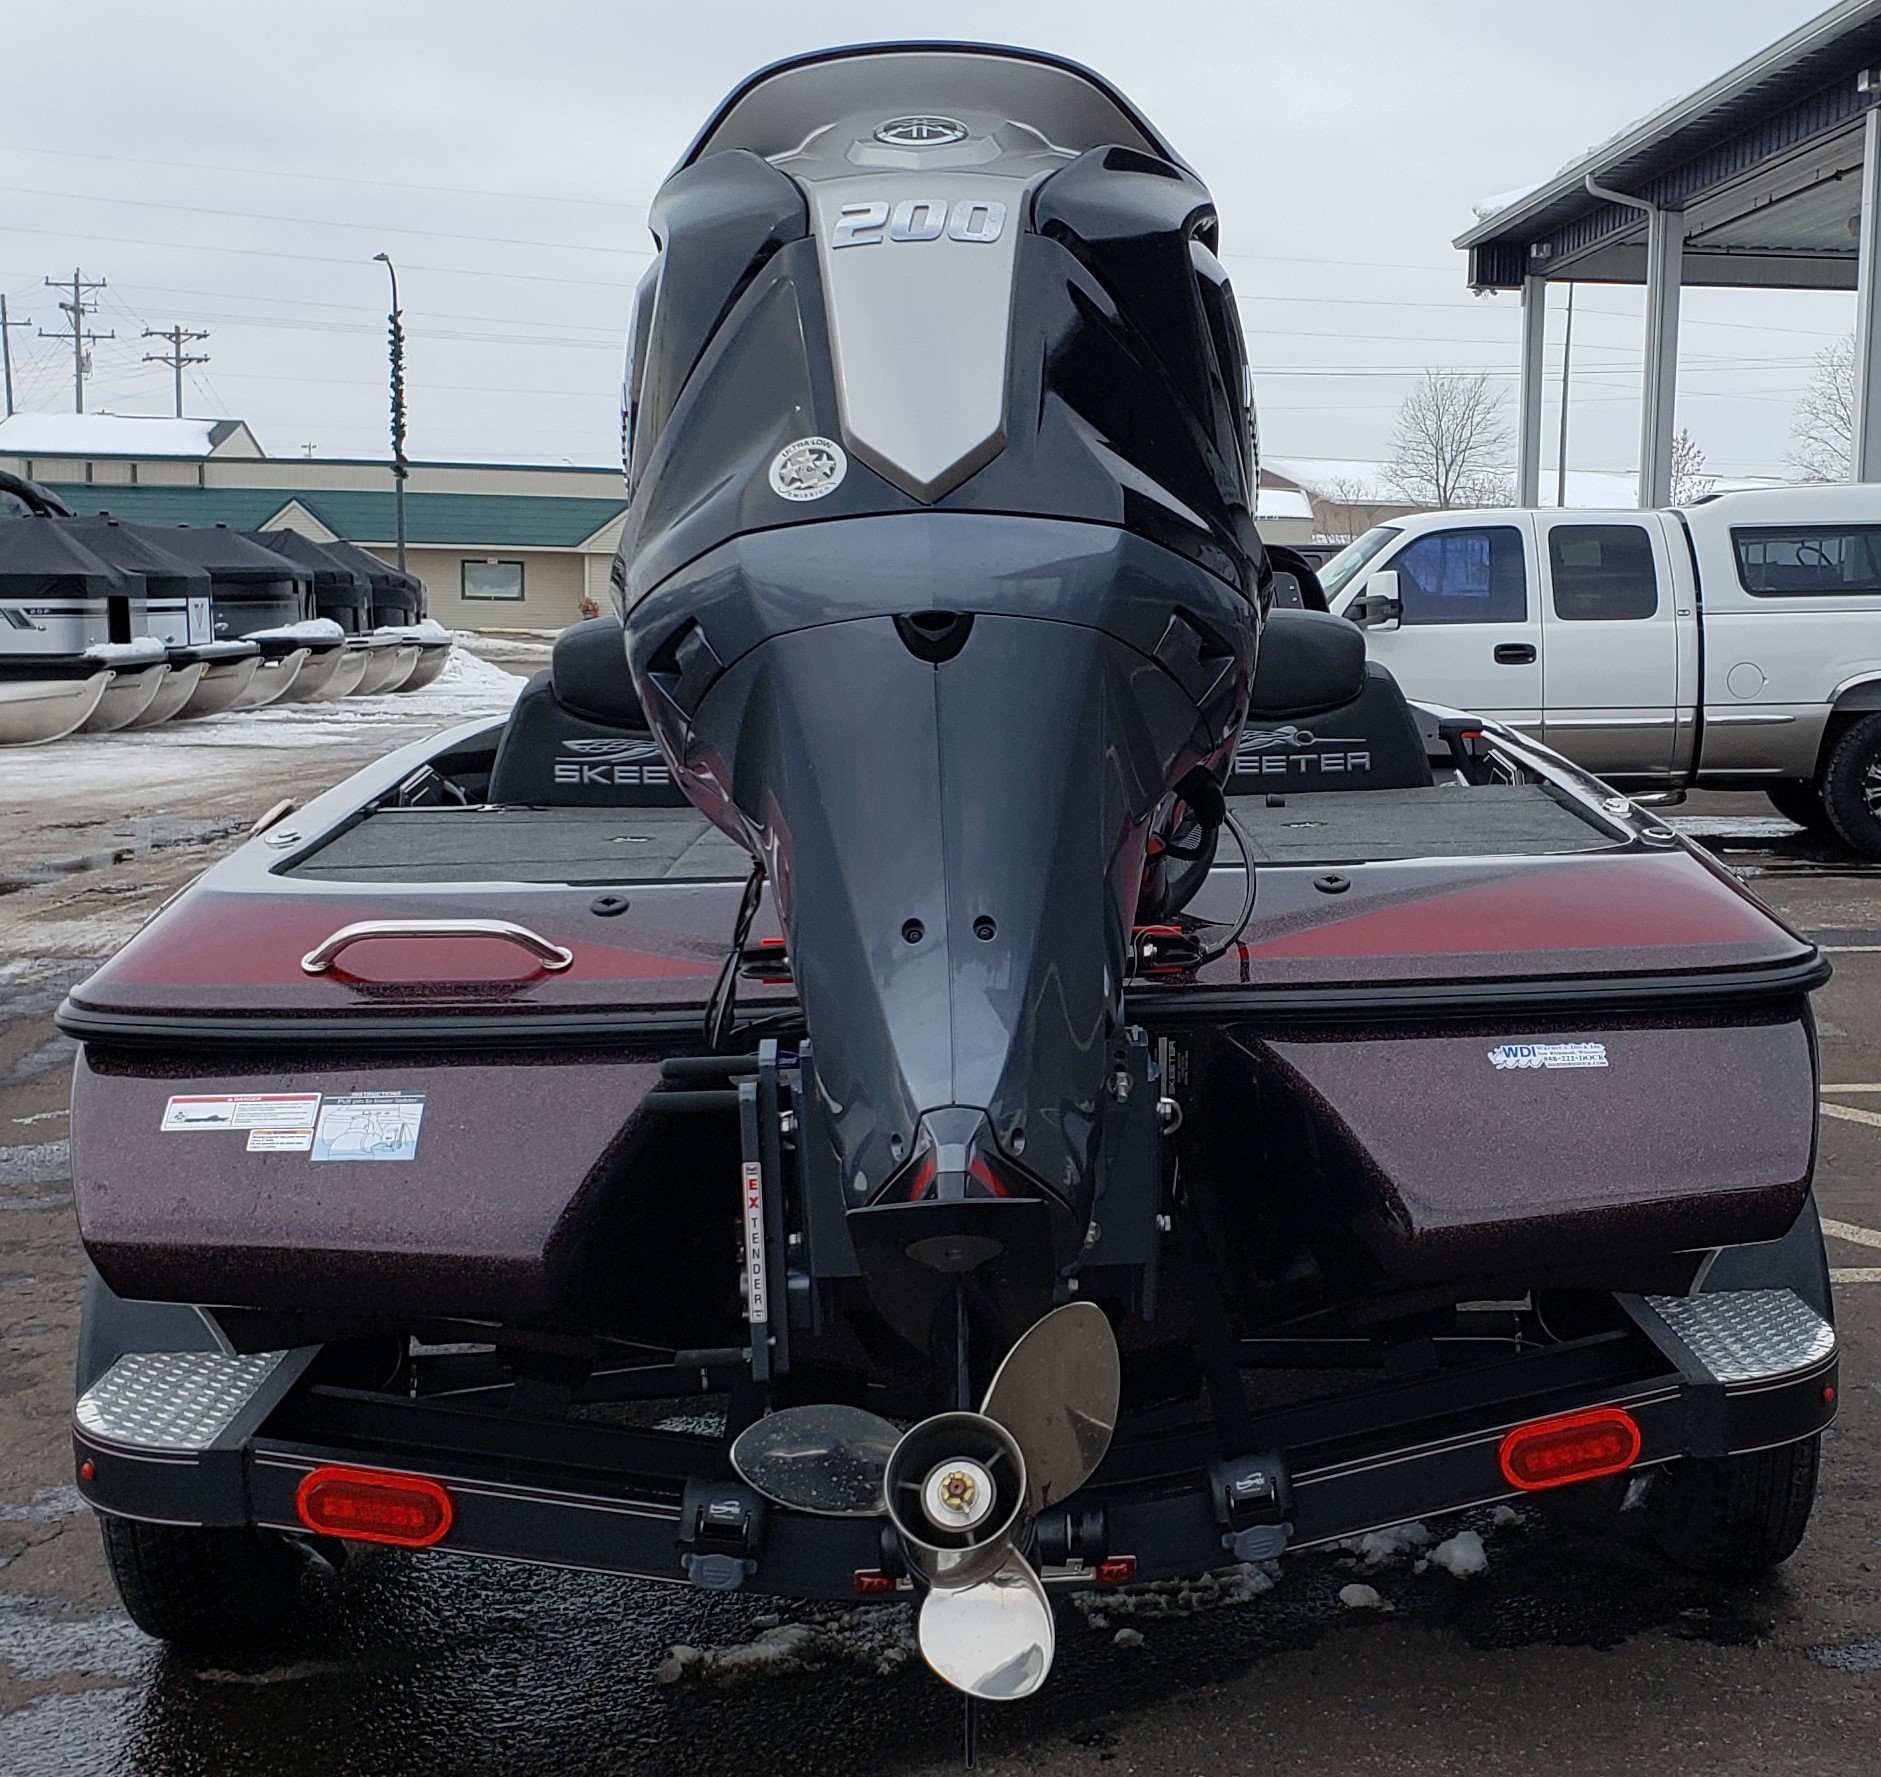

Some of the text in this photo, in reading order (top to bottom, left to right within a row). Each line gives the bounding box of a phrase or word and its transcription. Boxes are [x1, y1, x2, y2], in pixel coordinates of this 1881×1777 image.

[832, 200, 1006, 249] 200
[1231, 752, 1370, 775] EETER
[554, 765, 669, 784] SKEE
[1503, 1046, 1537, 1058] WDI
